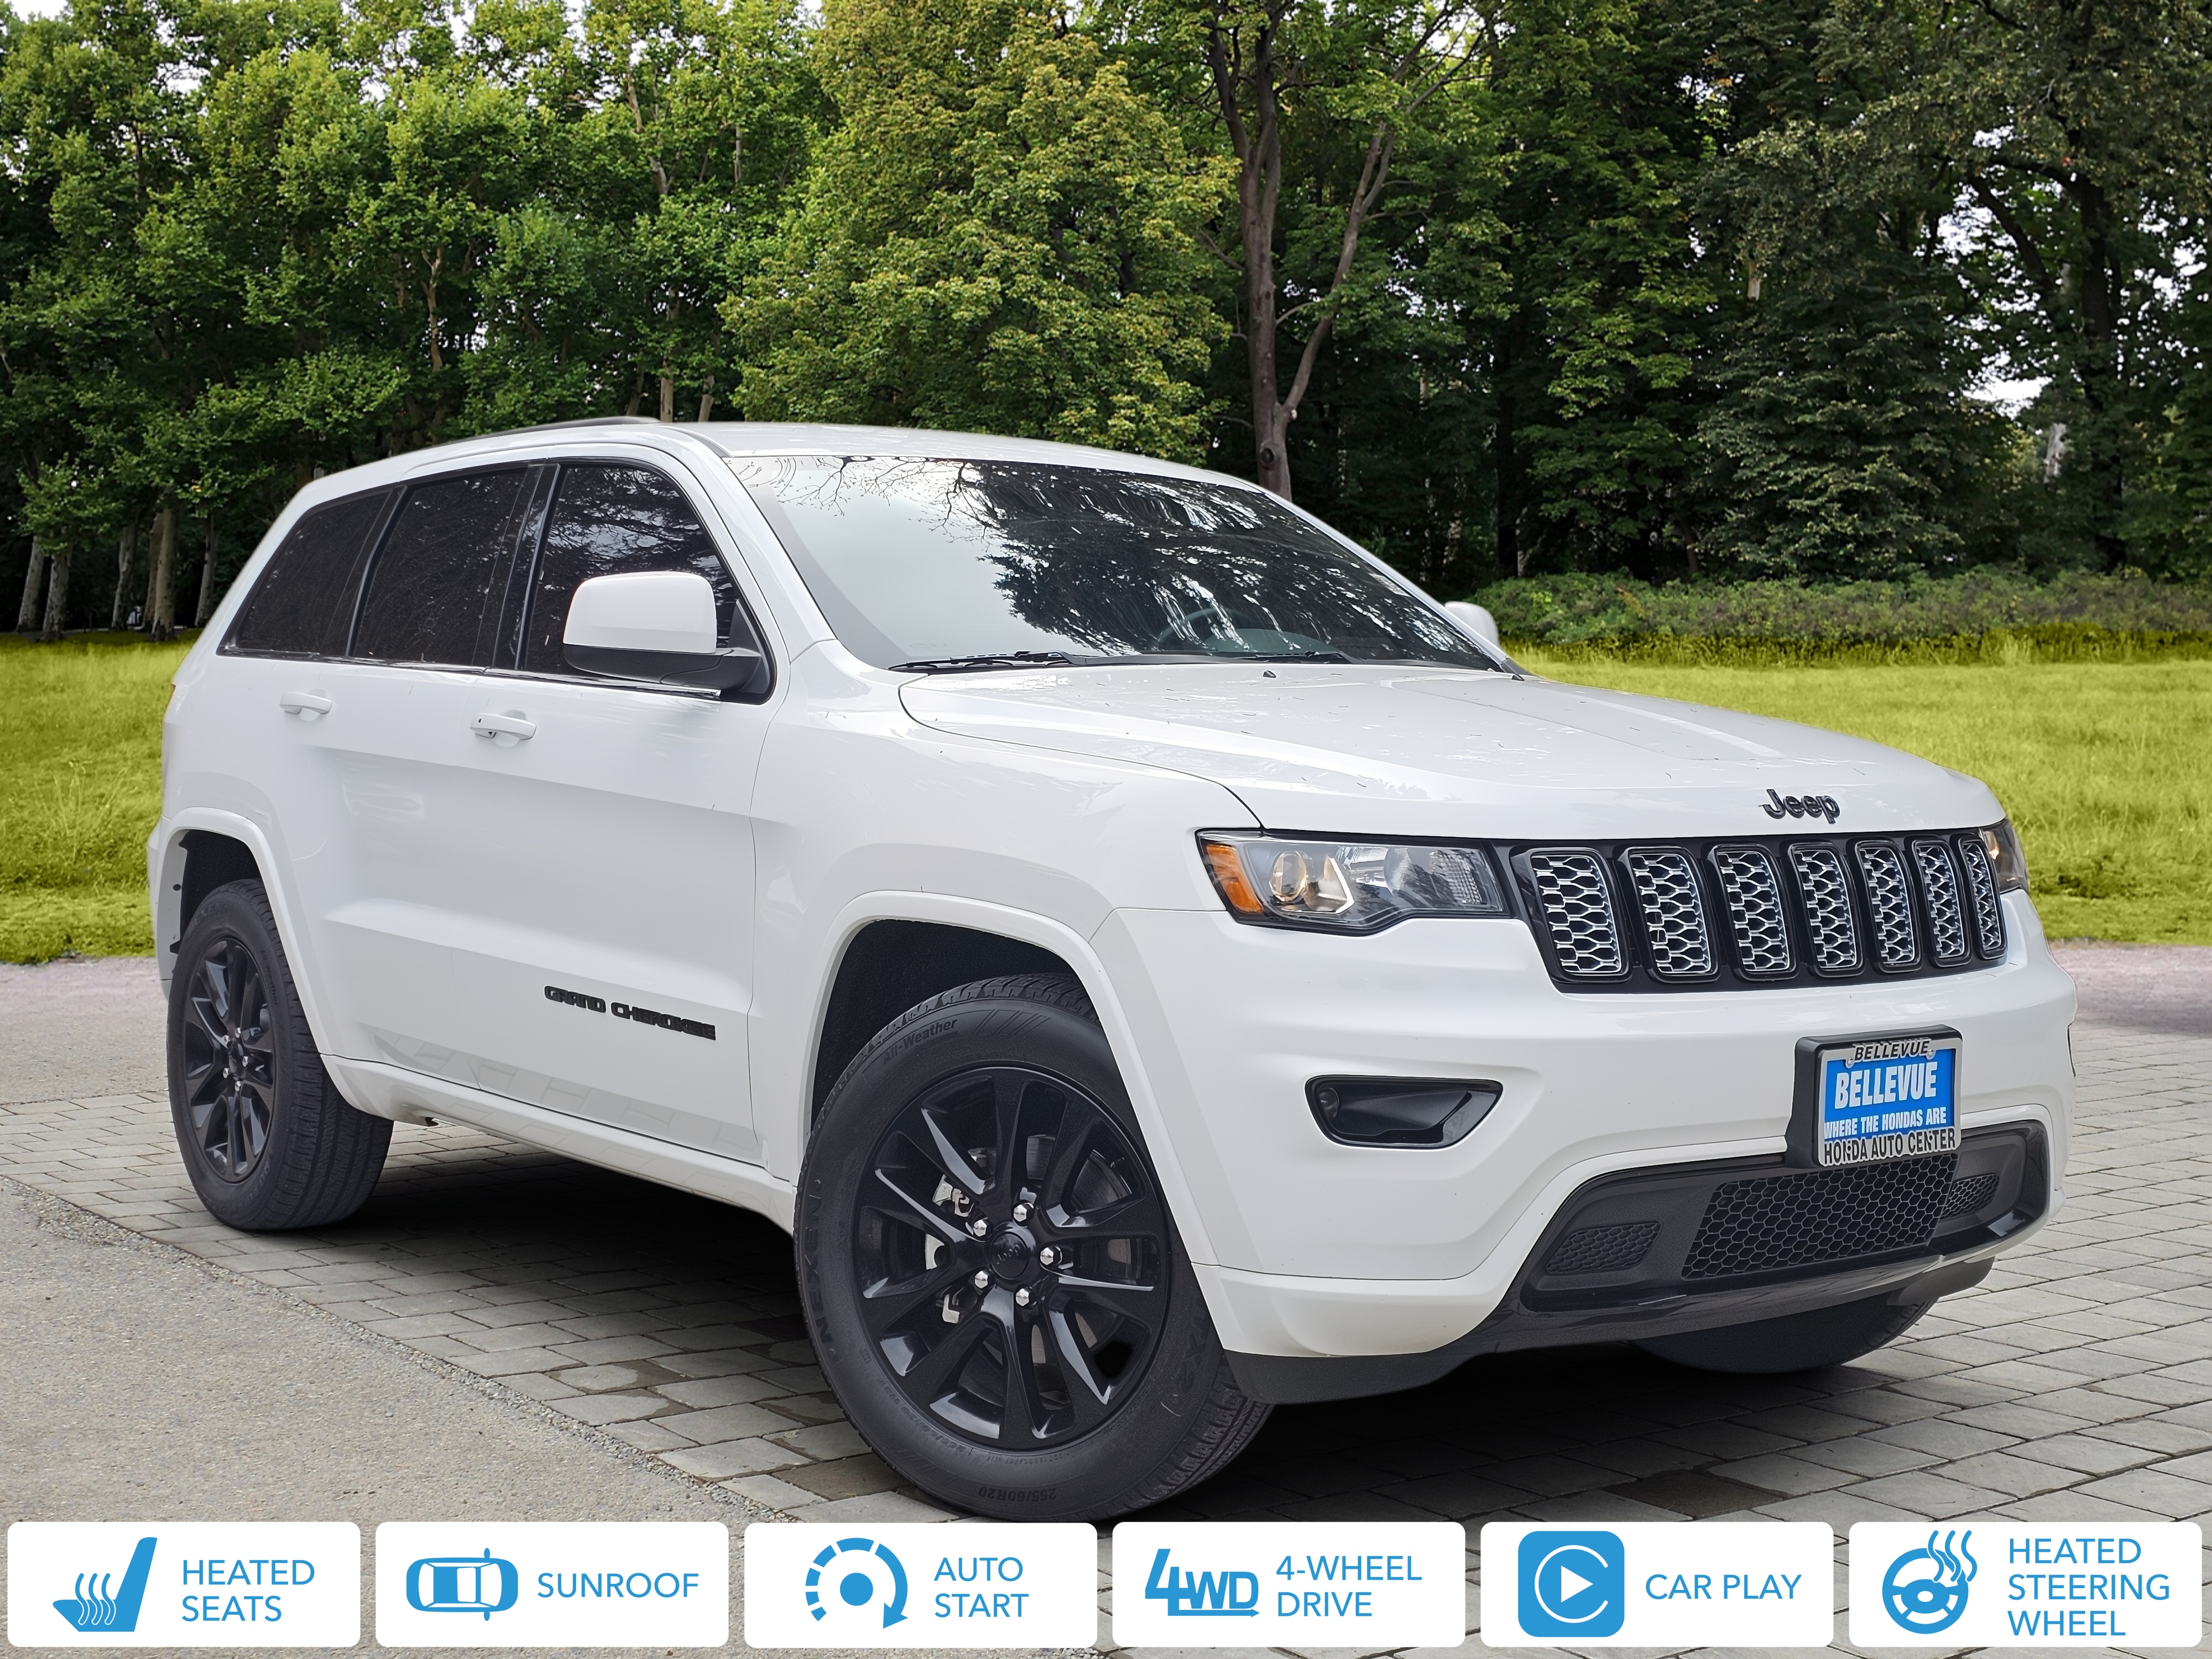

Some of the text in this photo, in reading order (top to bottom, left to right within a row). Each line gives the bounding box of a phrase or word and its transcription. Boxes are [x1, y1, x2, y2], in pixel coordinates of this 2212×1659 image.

[1762, 789, 1841, 825] Jeep
[544, 985, 716, 1041] GRAND CHEROKEE
[883, 1019, 958, 1062] All-Weather
[1854, 1041, 1929, 1061] BELLEVUE
[1834, 1062, 1938, 1109] BELLEVUE
[1824, 1107, 1947, 1139] WHERE THE HONDAS ARE
[1824, 1128, 1955, 1165] HONDA AUTO CENTER
[978, 1486, 1057, 1503] 255/60R20
